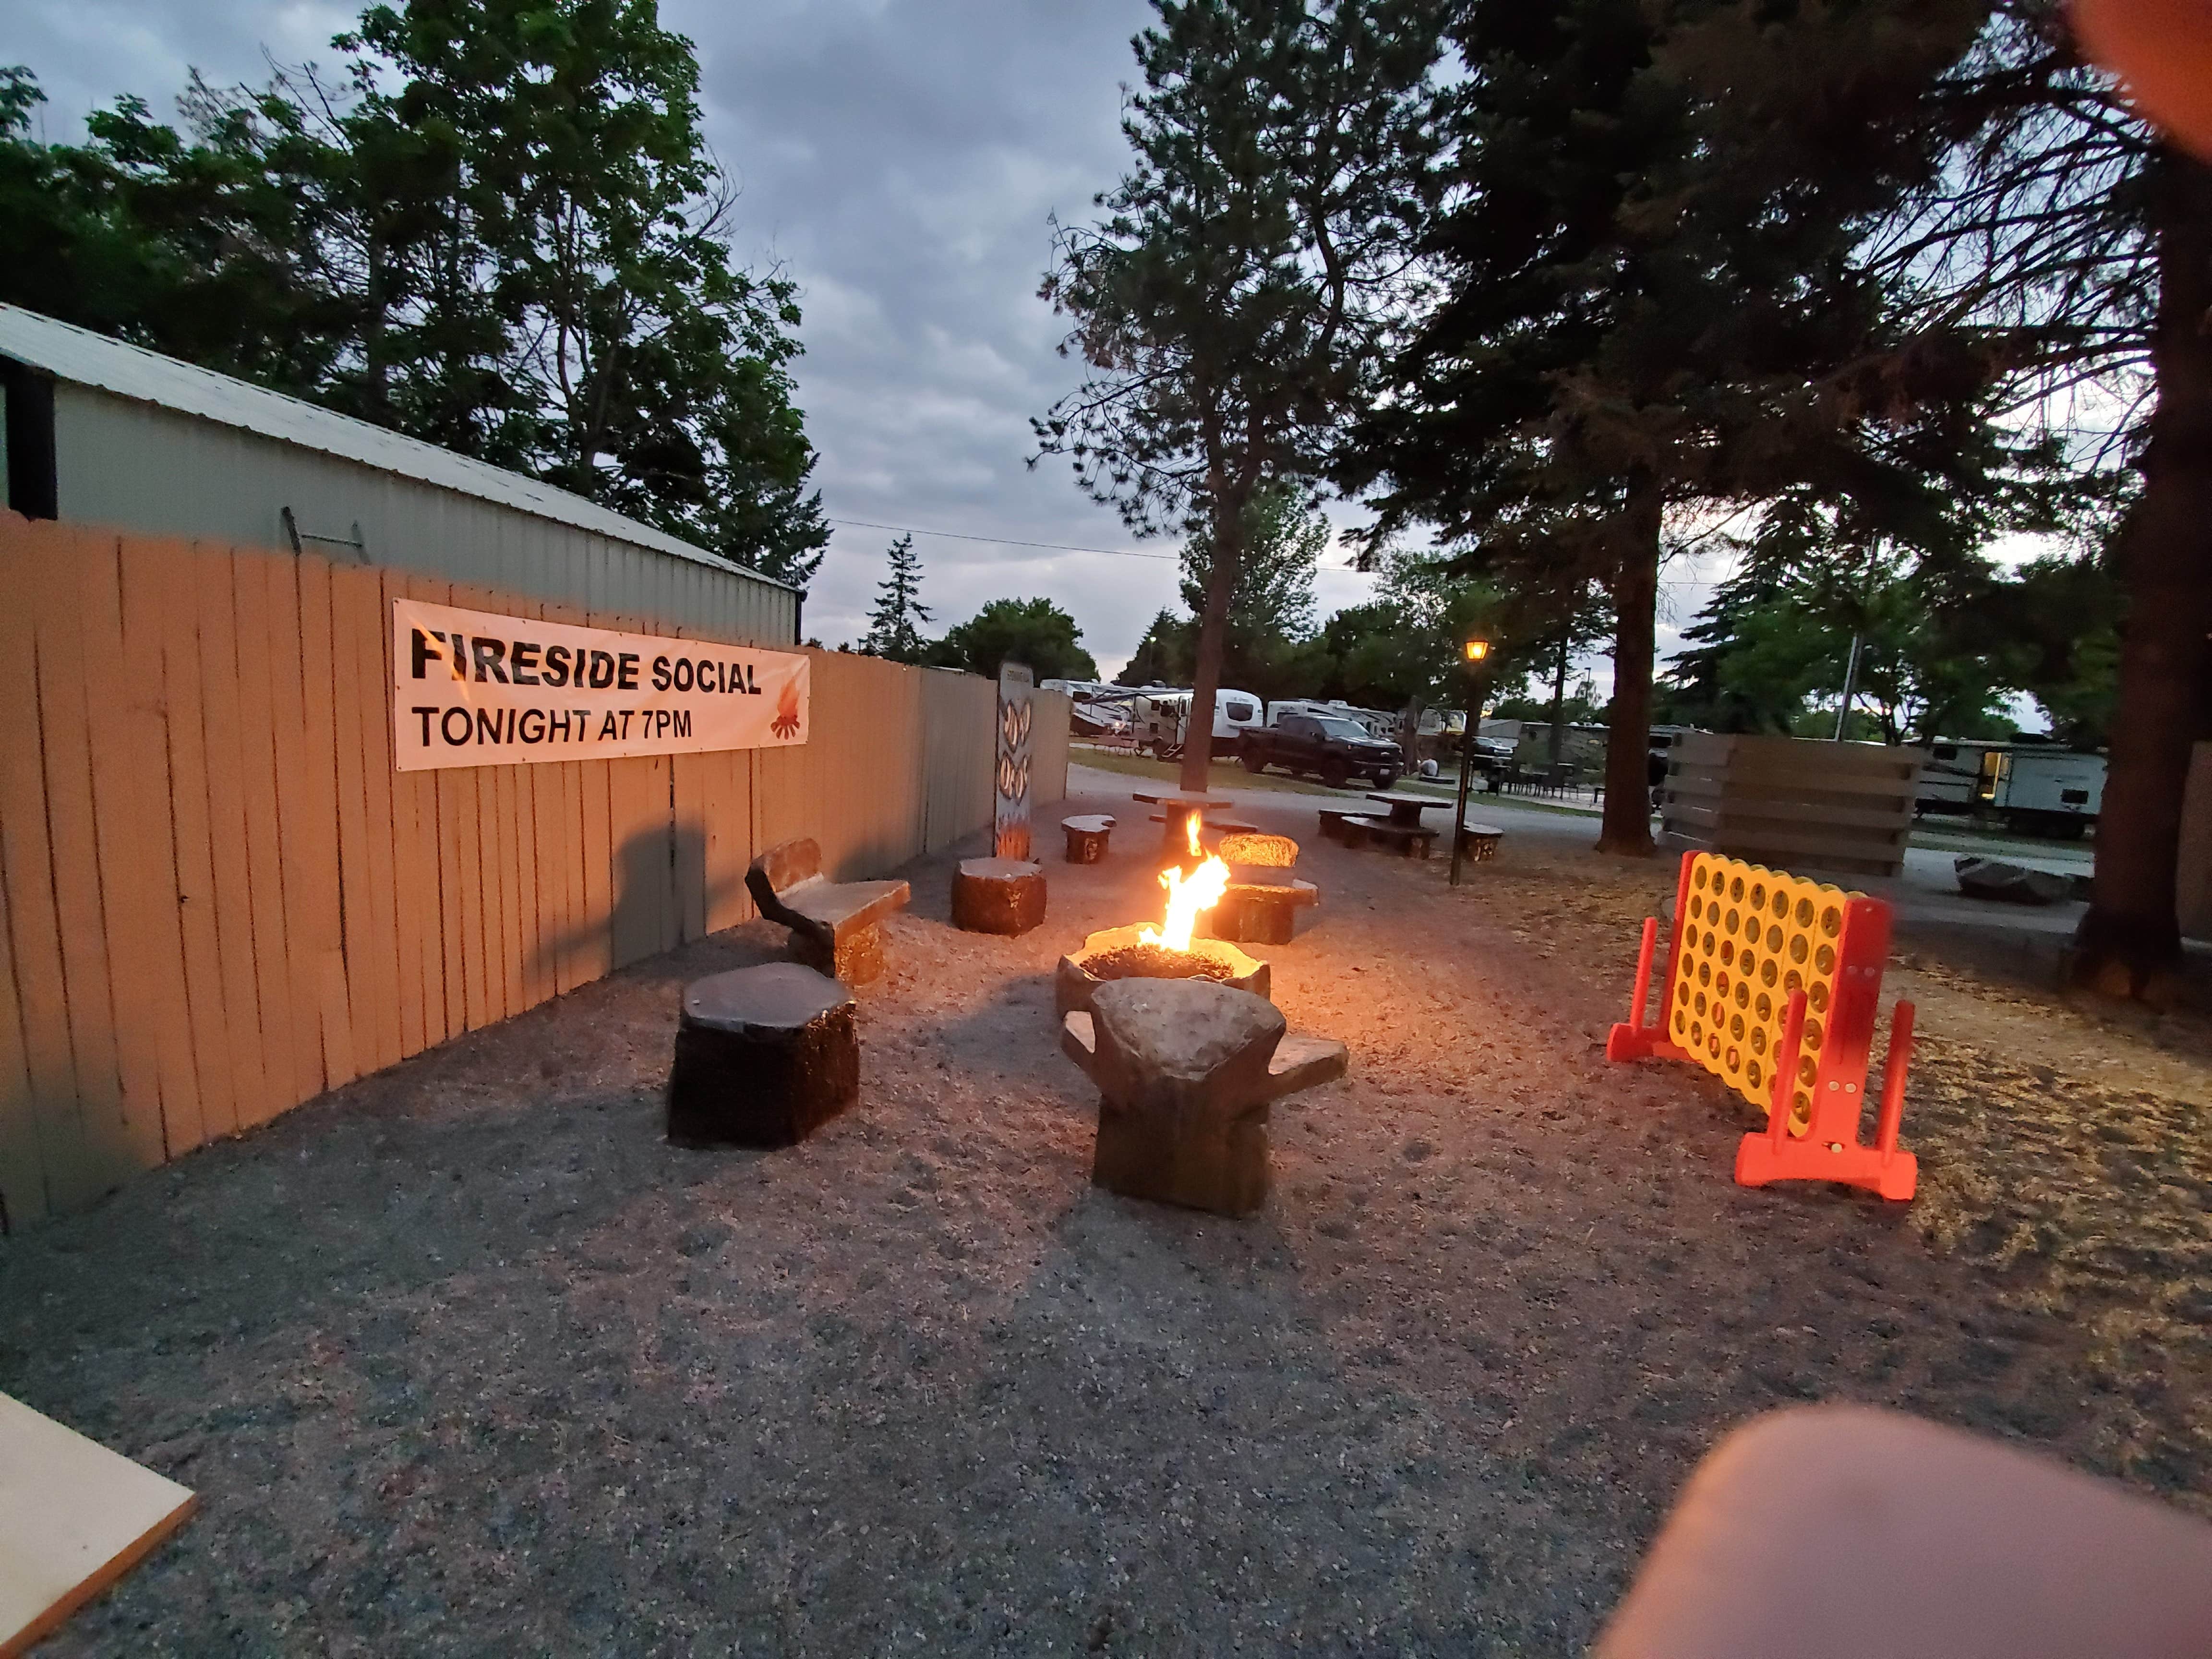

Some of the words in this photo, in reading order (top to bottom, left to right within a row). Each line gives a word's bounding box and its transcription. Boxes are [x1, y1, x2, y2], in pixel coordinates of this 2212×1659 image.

[411, 628, 639, 690] FIRESIDE
[651, 655, 762, 694] SOCIAL
[411, 707, 591, 746] TONIGHT
[598, 710, 635, 741] AT
[643, 710, 692, 738] 7PM
